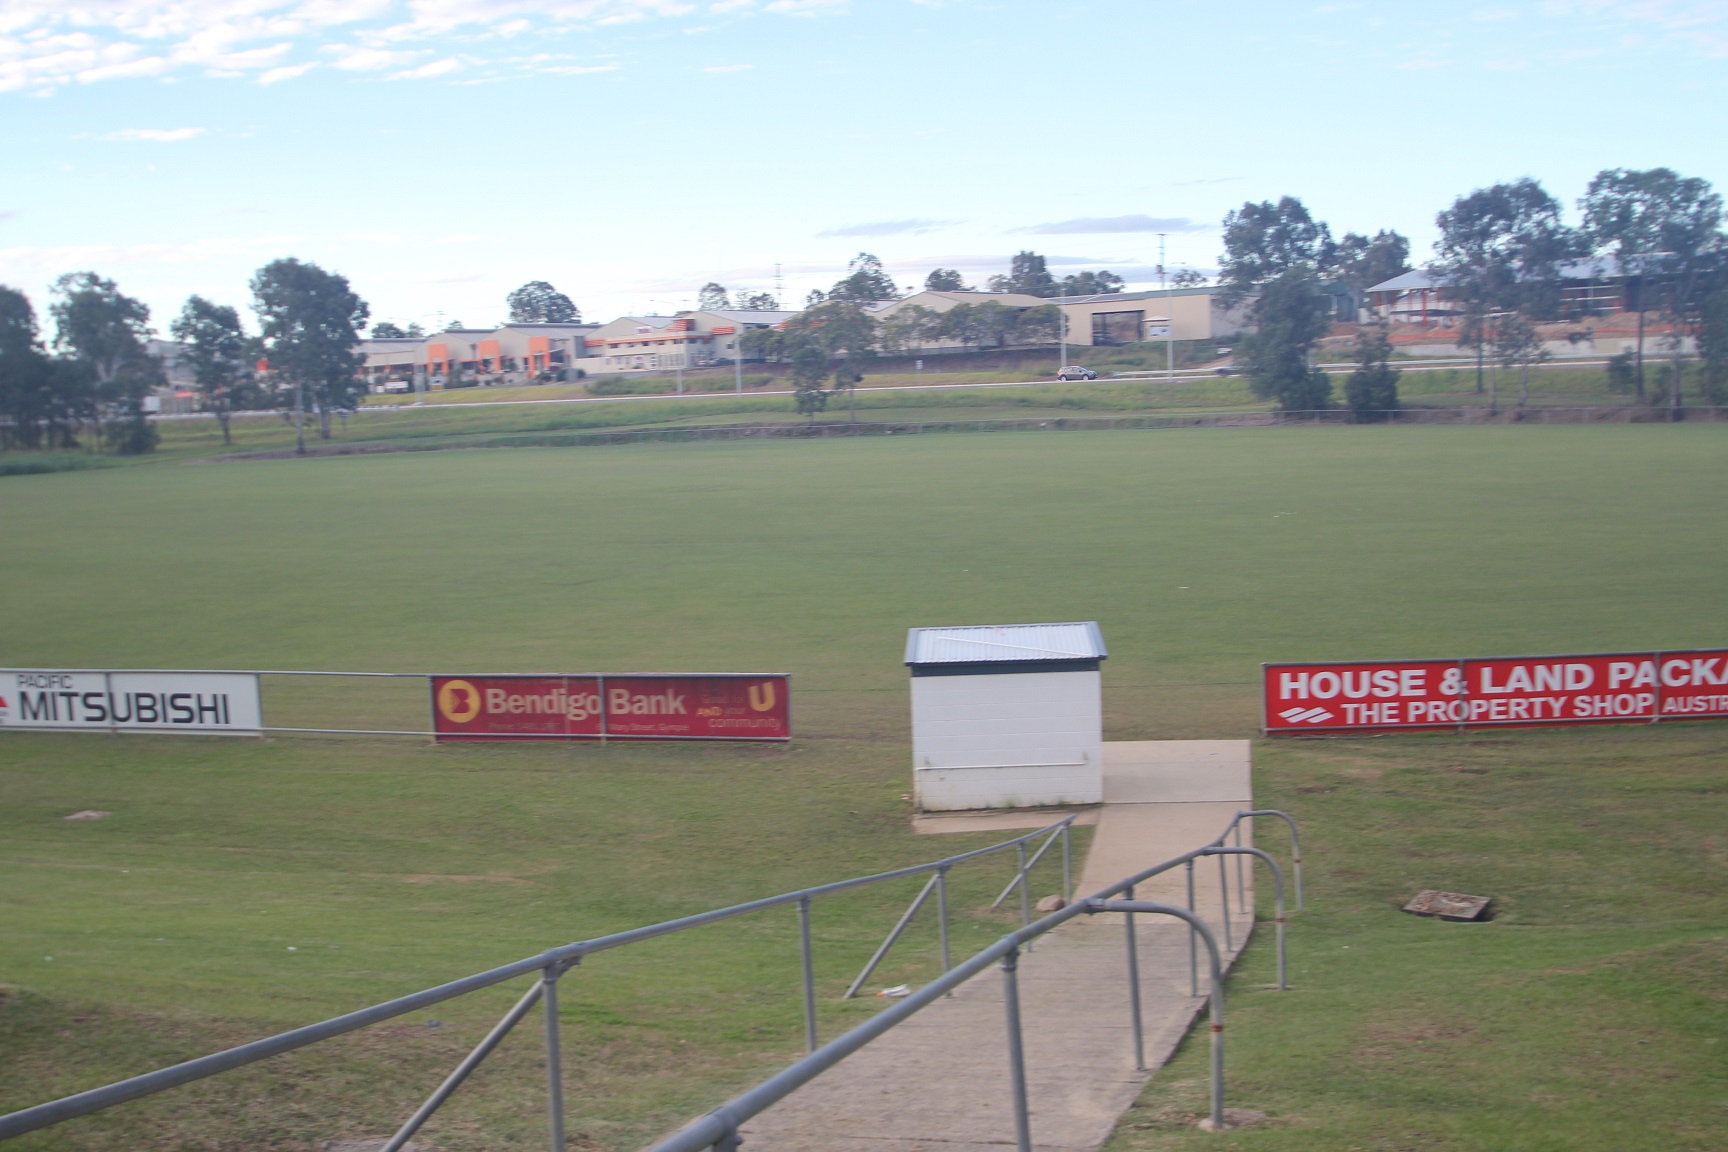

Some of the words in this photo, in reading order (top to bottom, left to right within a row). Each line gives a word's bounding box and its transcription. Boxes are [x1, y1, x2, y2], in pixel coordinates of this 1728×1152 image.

[17, 674, 73, 689] PACIFIC
[1280, 669, 1427, 699] HOUSE
[1438, 666, 1468, 695] &
[1480, 663, 1595, 694] LAND
[19, 691, 230, 725] MITSUBISHI
[485, 688, 601, 721] Bendigo
[608, 688, 687, 716] Bank
[1340, 702, 1400, 724] THE
[1408, 696, 1565, 723] PROPERTY
[1572, 693, 1656, 717] SHOP
